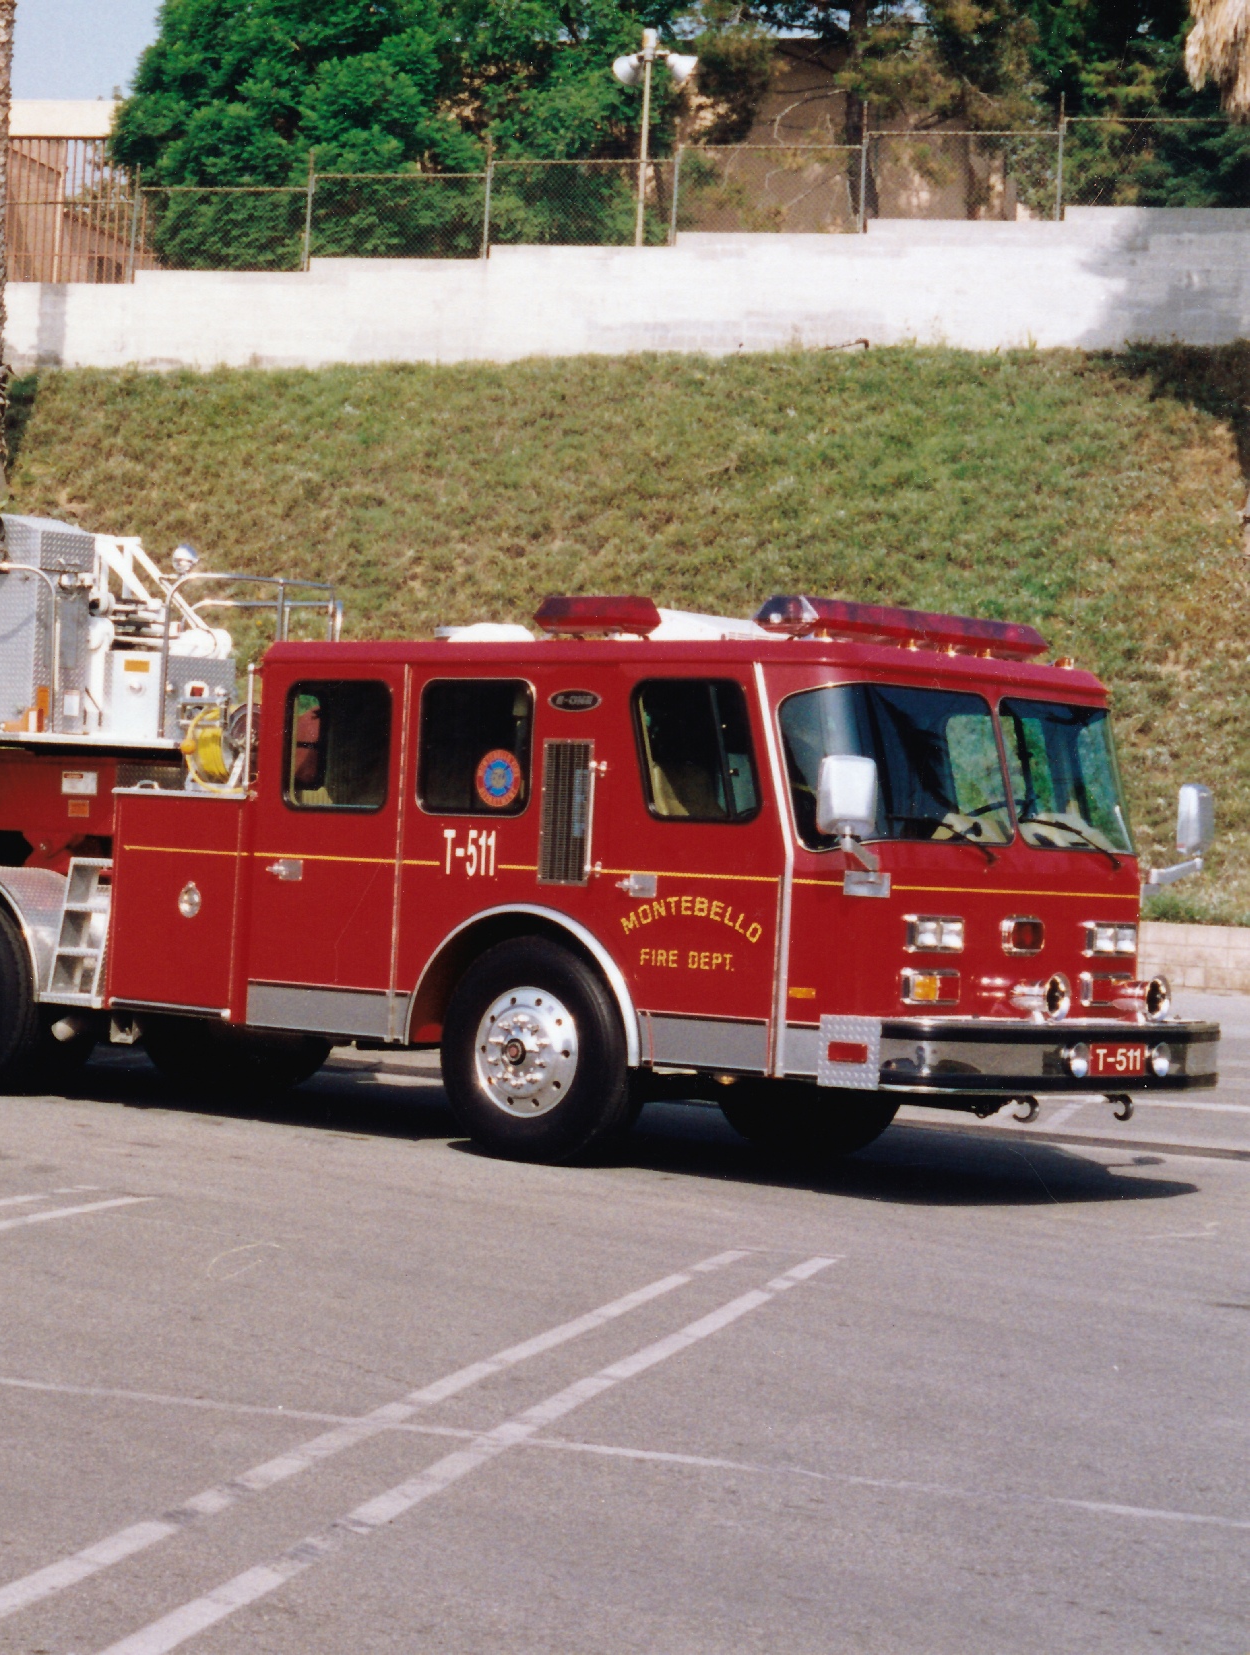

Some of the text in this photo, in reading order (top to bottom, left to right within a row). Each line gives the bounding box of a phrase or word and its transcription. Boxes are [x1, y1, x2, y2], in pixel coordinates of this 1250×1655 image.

[443, 829, 497, 877] T-511
[620, 896, 763, 944] MONTEBELLO
[639, 948, 735, 972] FIRE DEPT.
[1095, 1048, 1141, 1072] T-511
